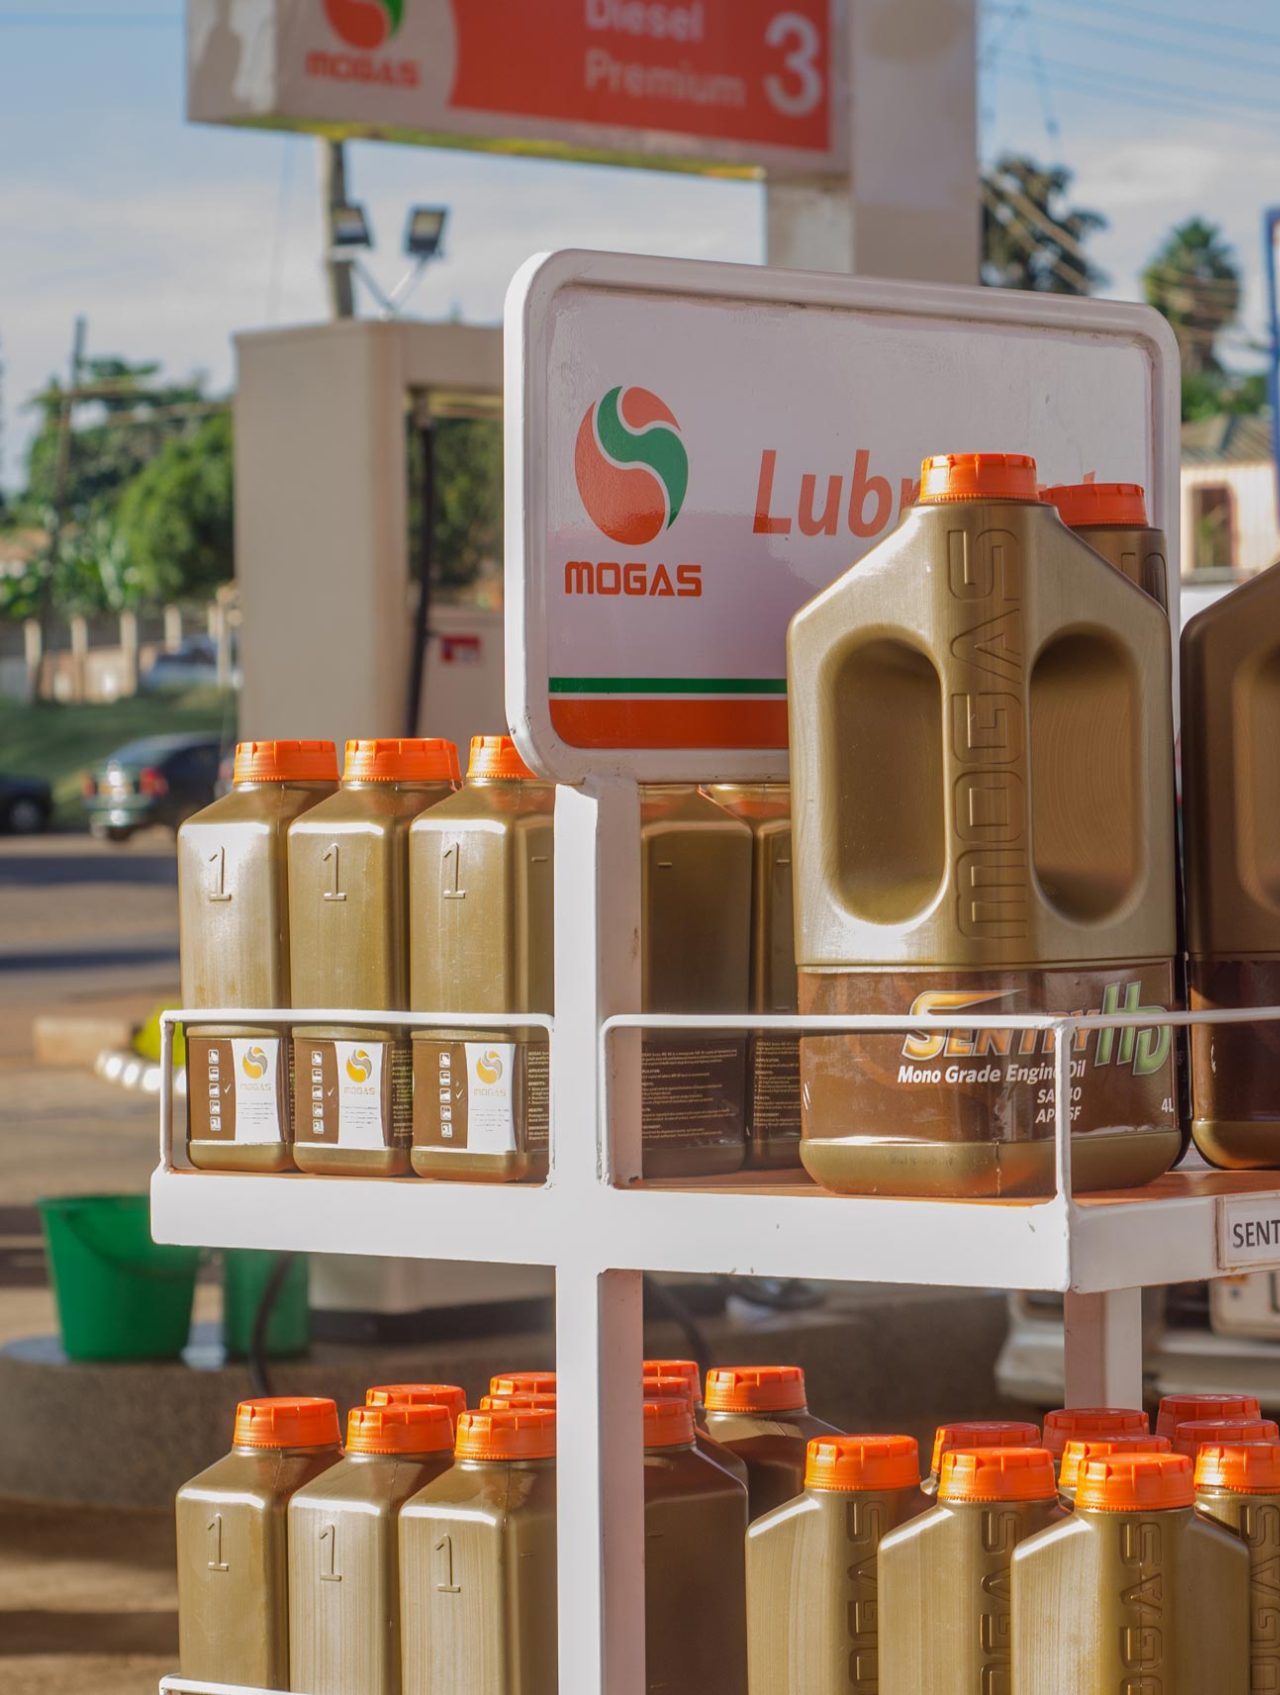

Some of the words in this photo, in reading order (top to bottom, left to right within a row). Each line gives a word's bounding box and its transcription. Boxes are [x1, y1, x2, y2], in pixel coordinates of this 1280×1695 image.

[585, 49, 747, 107] Premium
[763, 12, 822, 118] 3
[564, 561, 701, 597] MOGAS
[898, 1065, 940, 1084] Mono
[945, 1063, 1000, 1083] Grade
[1037, 1087, 1056, 1104] SA
[1035, 1107, 1056, 1124] AP
